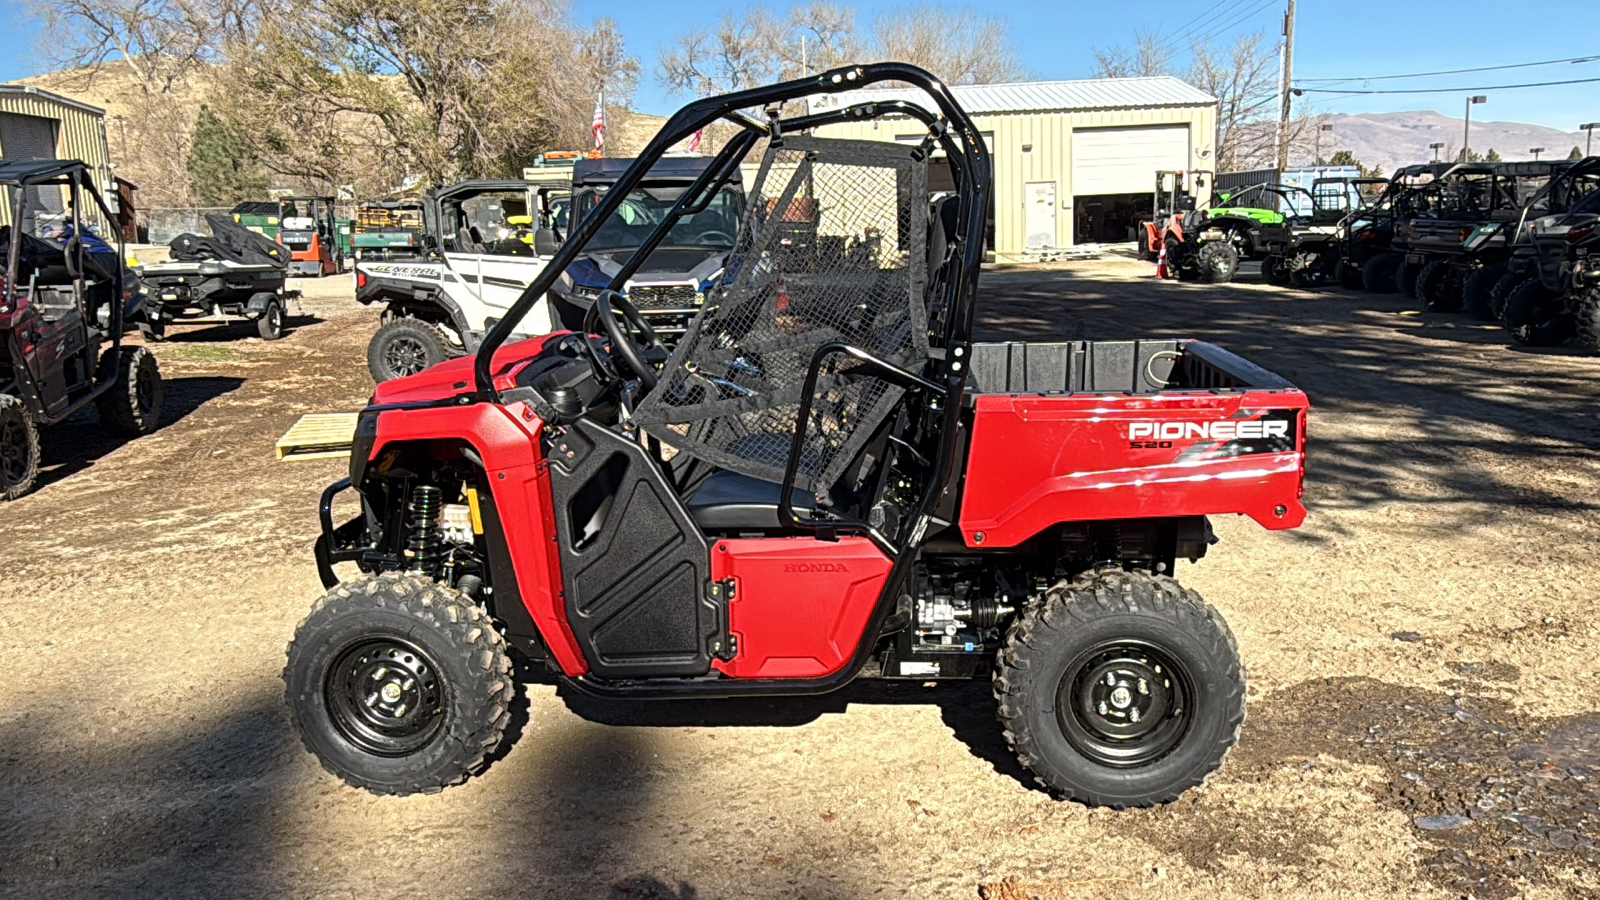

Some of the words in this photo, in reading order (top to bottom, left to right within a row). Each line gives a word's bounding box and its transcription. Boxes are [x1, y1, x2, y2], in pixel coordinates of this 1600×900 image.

[374, 265, 438, 276] GENERAL
[1128, 420, 1289, 440] PIONEER
[1129, 441, 1173, 449] 520
[783, 563, 849, 573] HONDA
